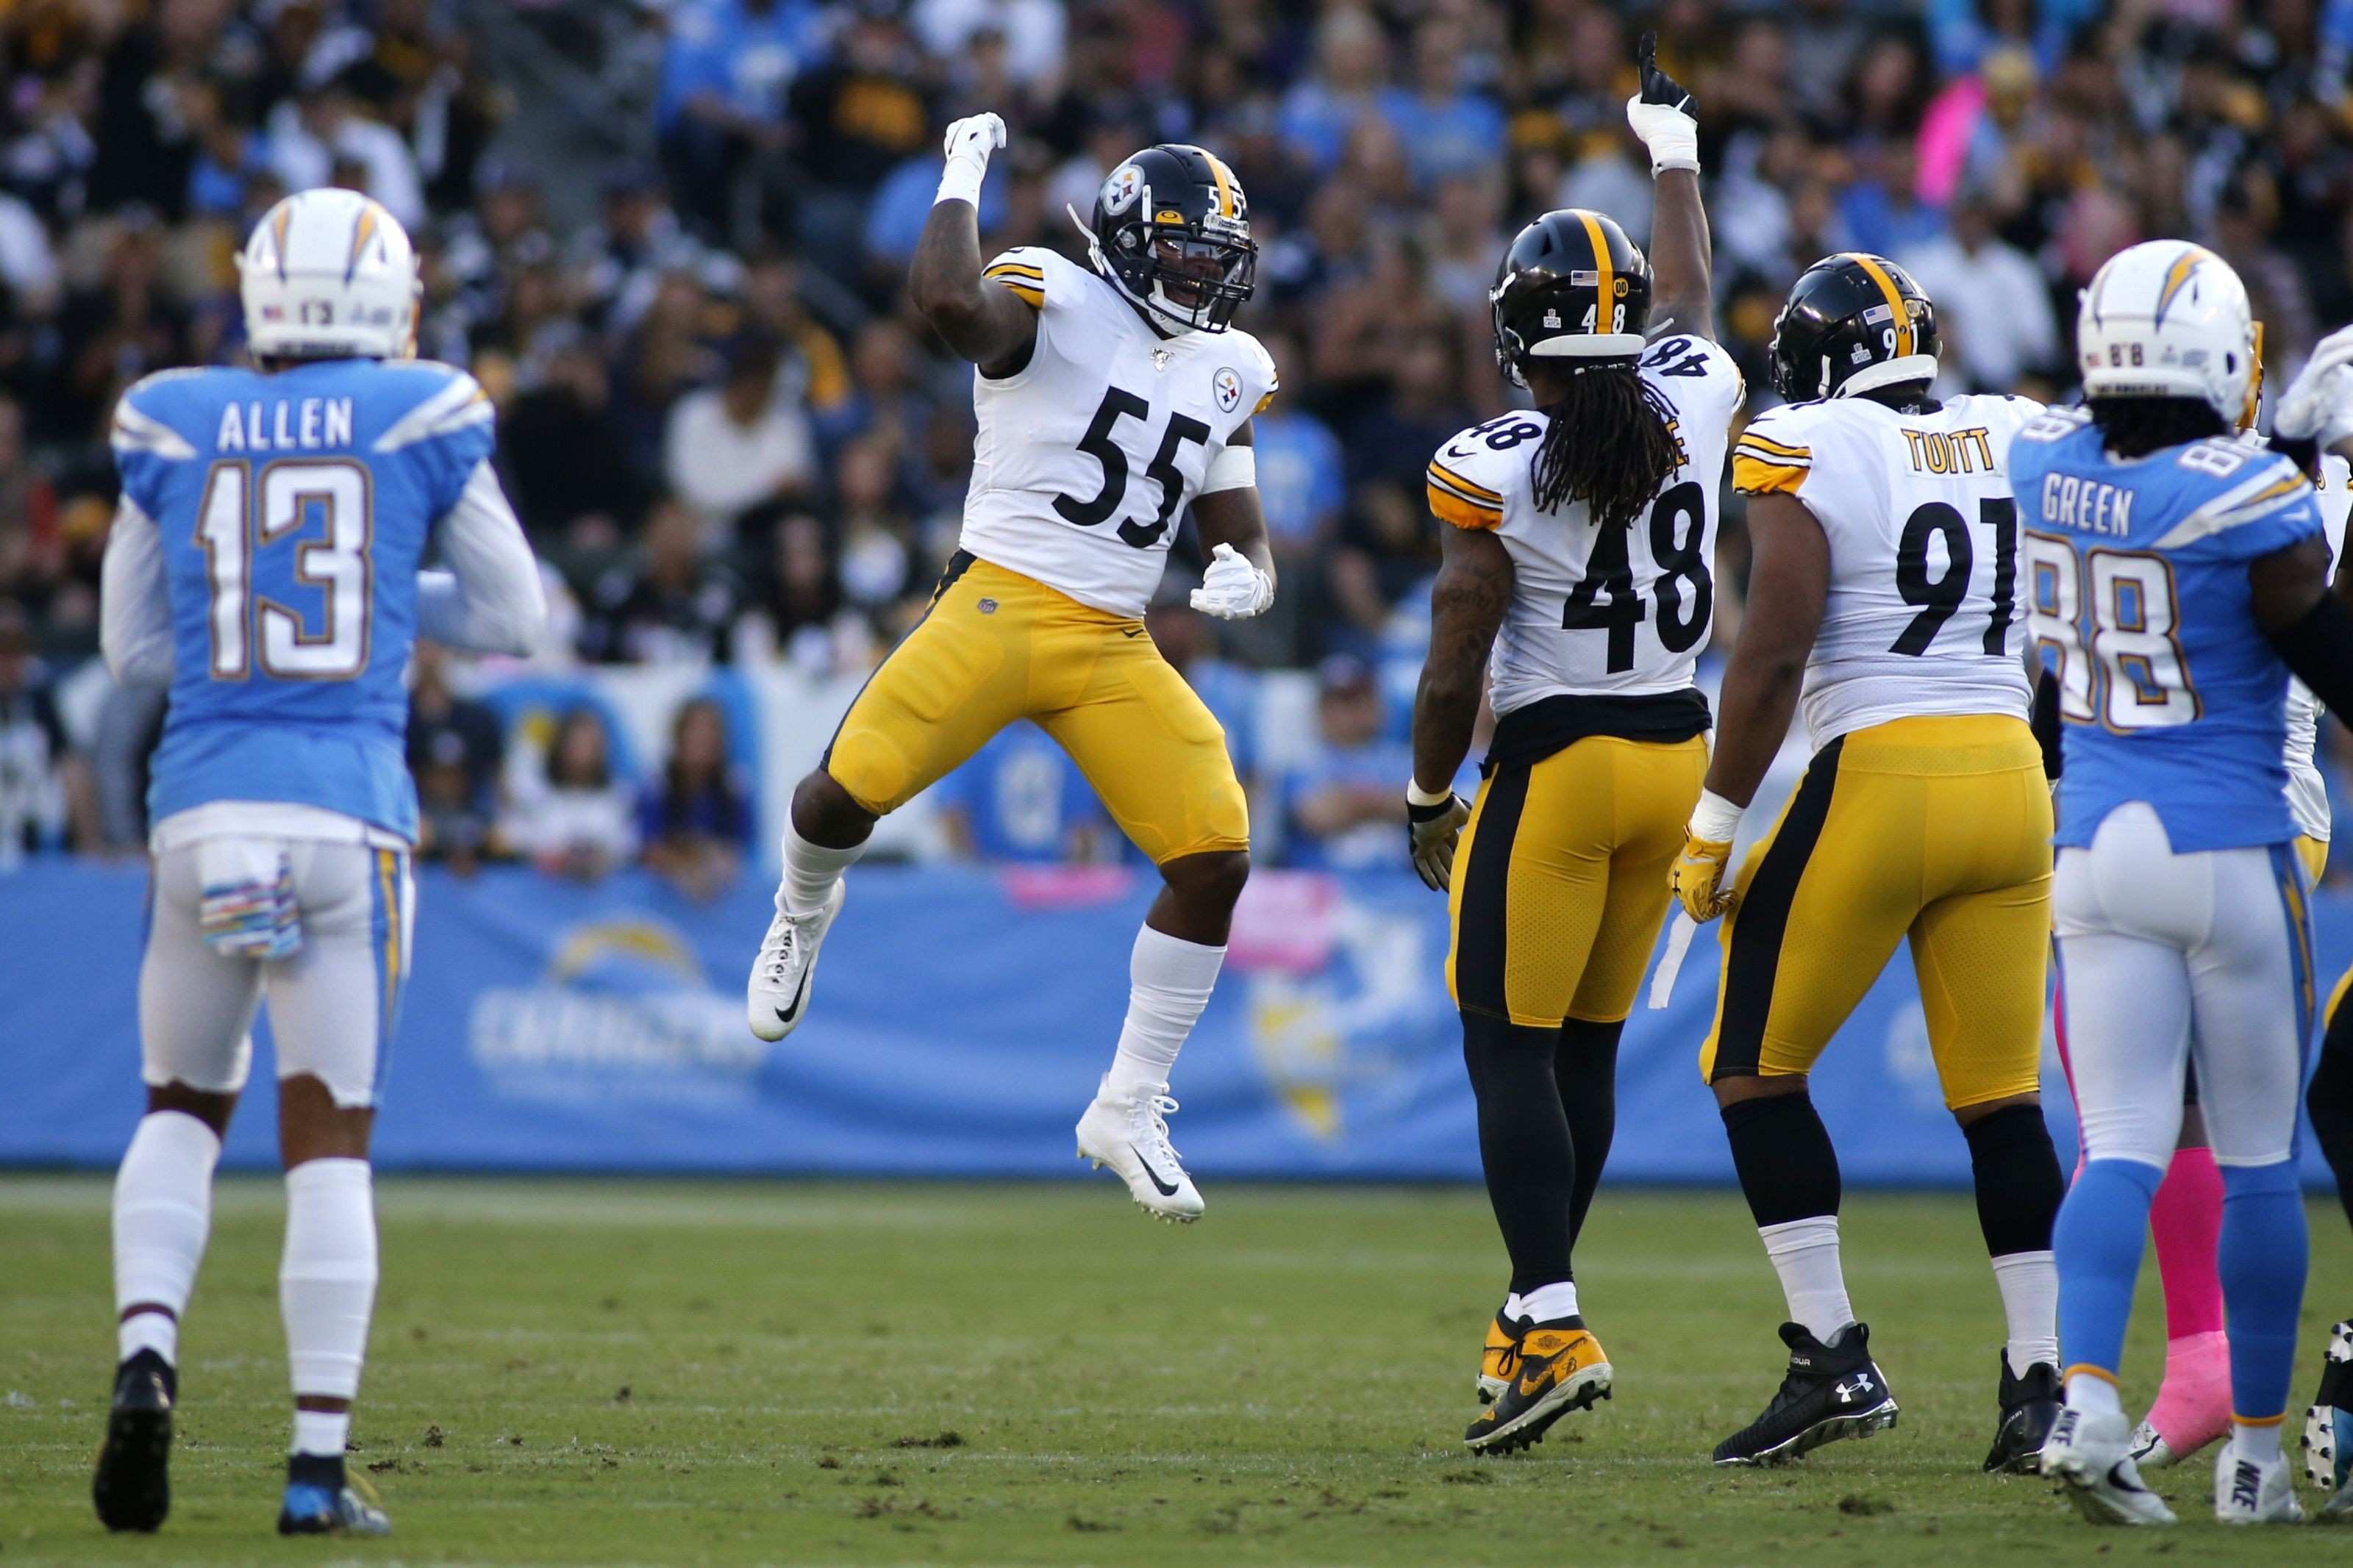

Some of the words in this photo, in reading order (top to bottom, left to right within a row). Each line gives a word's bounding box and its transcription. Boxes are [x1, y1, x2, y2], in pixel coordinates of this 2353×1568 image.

[1581, 304, 1626, 334] 48
[1882, 323, 1918, 360] 91
[2110, 343, 2143, 367] 88
[217, 396, 353, 452] ALLEN
[1901, 427, 1994, 474] TUITT
[1051, 385, 1211, 548] 55
[2042, 472, 2133, 537] GREEN
[193, 457, 374, 682] 13
[1562, 482, 1713, 674] 48
[1888, 496, 2018, 656] 91
[2024, 529, 2203, 735] 88
[2052, 1410, 2080, 1447] NIKE
[2232, 1459, 2261, 1512] NIKE
